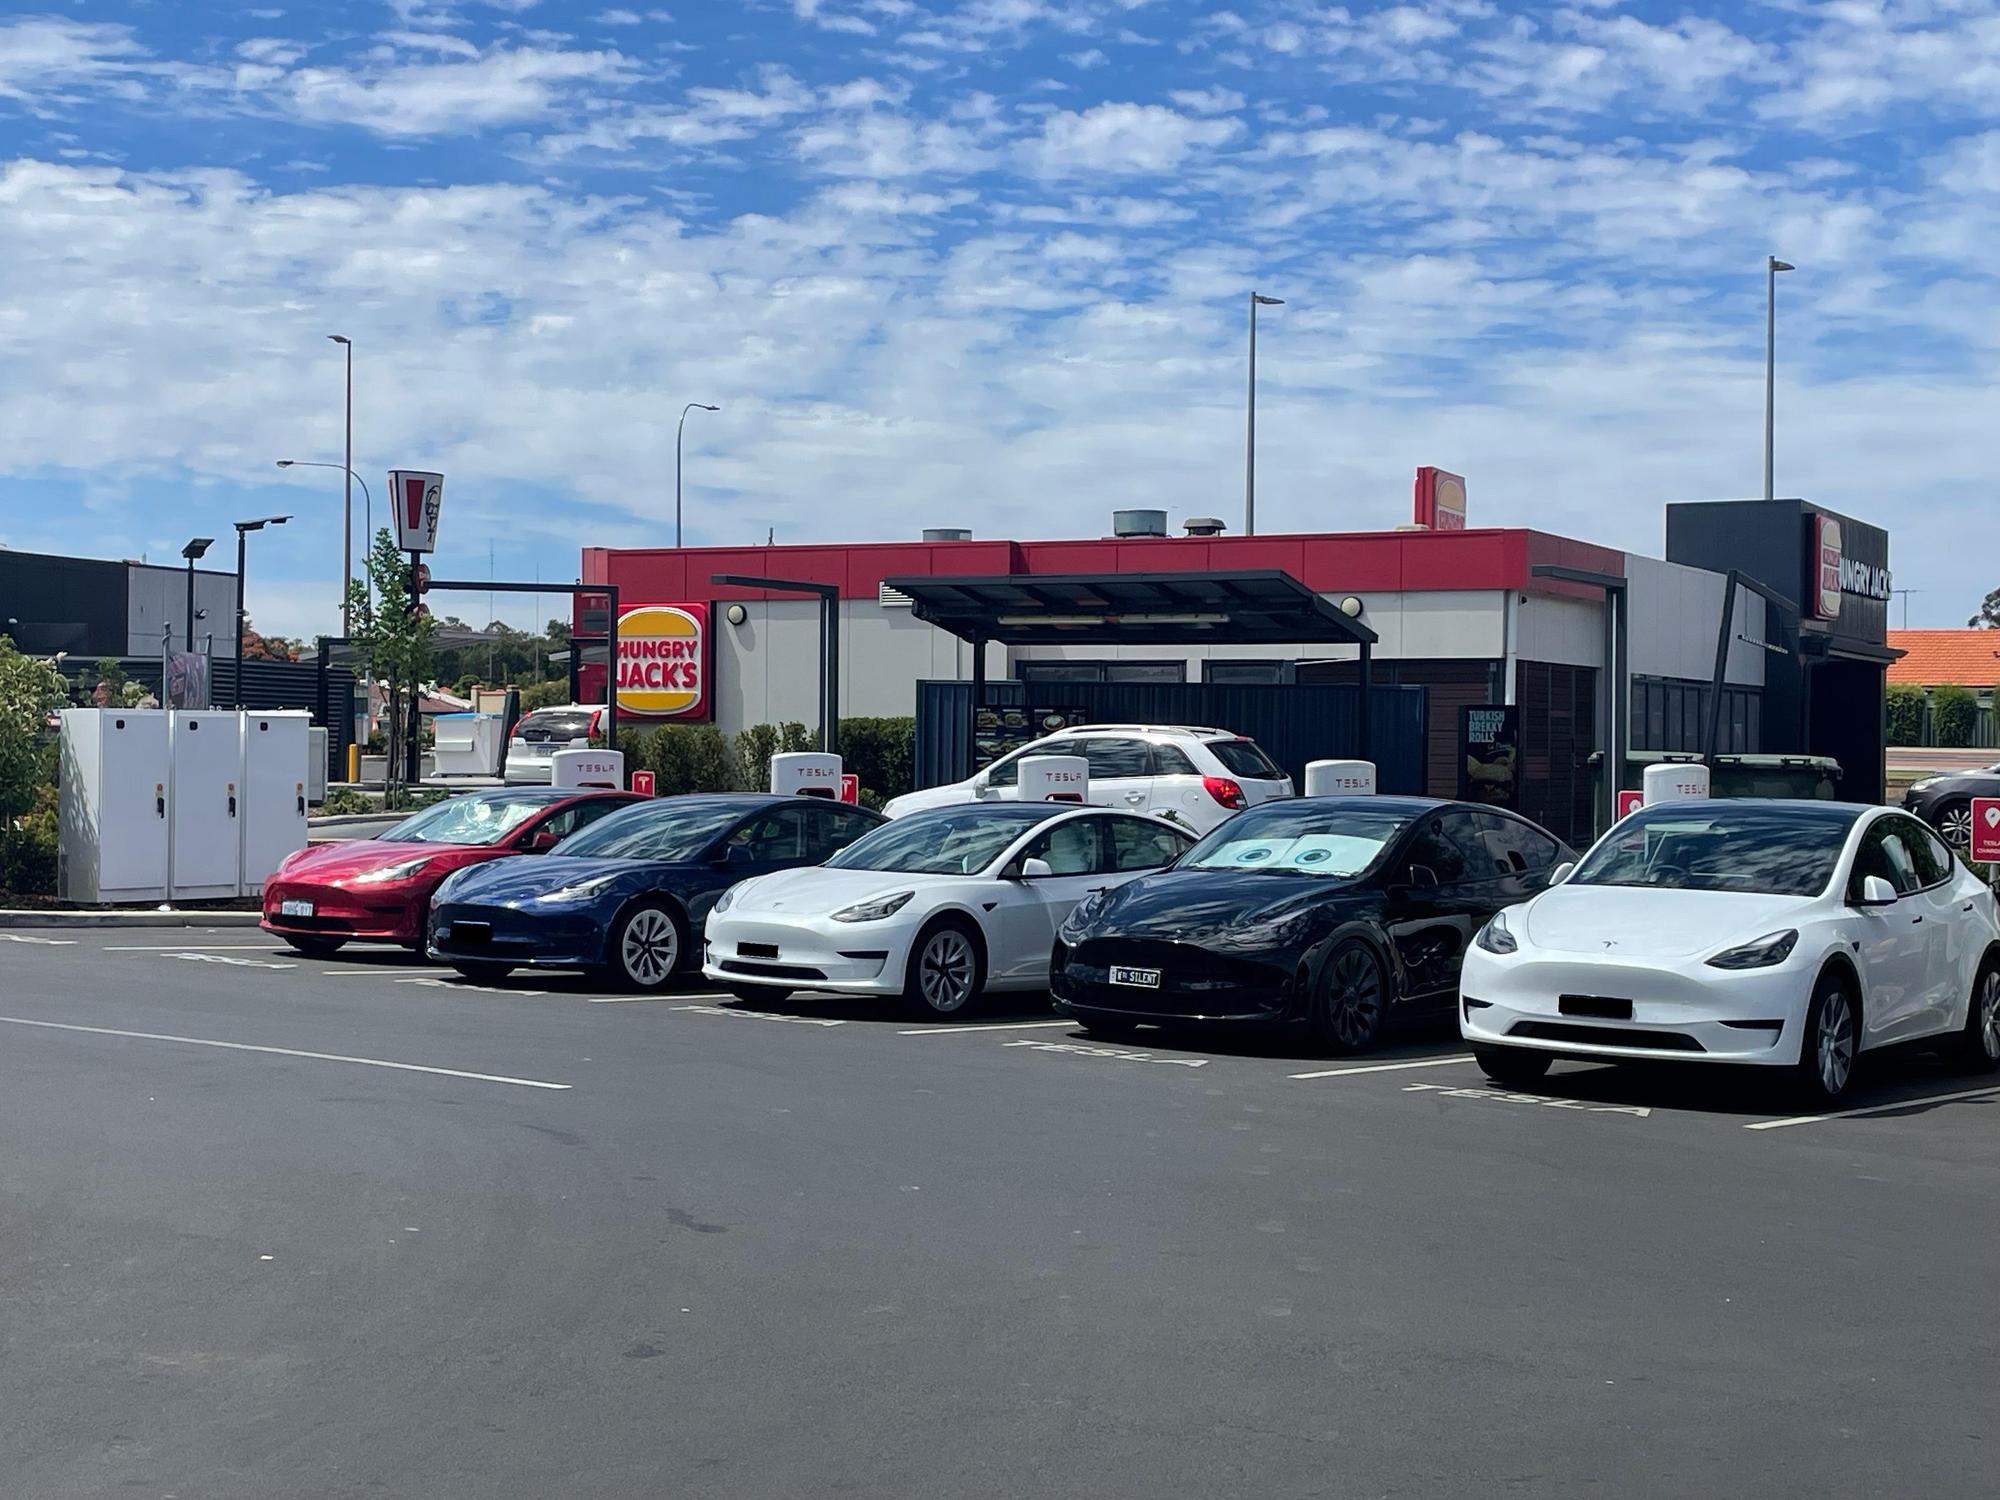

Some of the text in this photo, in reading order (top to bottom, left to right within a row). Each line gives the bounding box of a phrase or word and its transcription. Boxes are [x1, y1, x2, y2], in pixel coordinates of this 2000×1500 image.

[617, 641, 697, 658] HUNGRY
[616, 662, 697, 688] JACK'S
[1469, 710, 1505, 722] TURKISH
[1469, 721, 1503, 732] BREKKY
[1469, 732, 1495, 743] ROLLS
[577, 764, 615, 773] TESLA
[797, 768, 834, 777] TESLA
[1045, 772, 1082, 781] TESLA
[1335, 778, 1370, 788] TESLA
[1676, 784, 1707, 794] TESLA
[1129, 971, 1157, 984] SILENT
[1002, 1039, 1208, 1067] TESLA
[1401, 1083, 1651, 1118] TESLA
